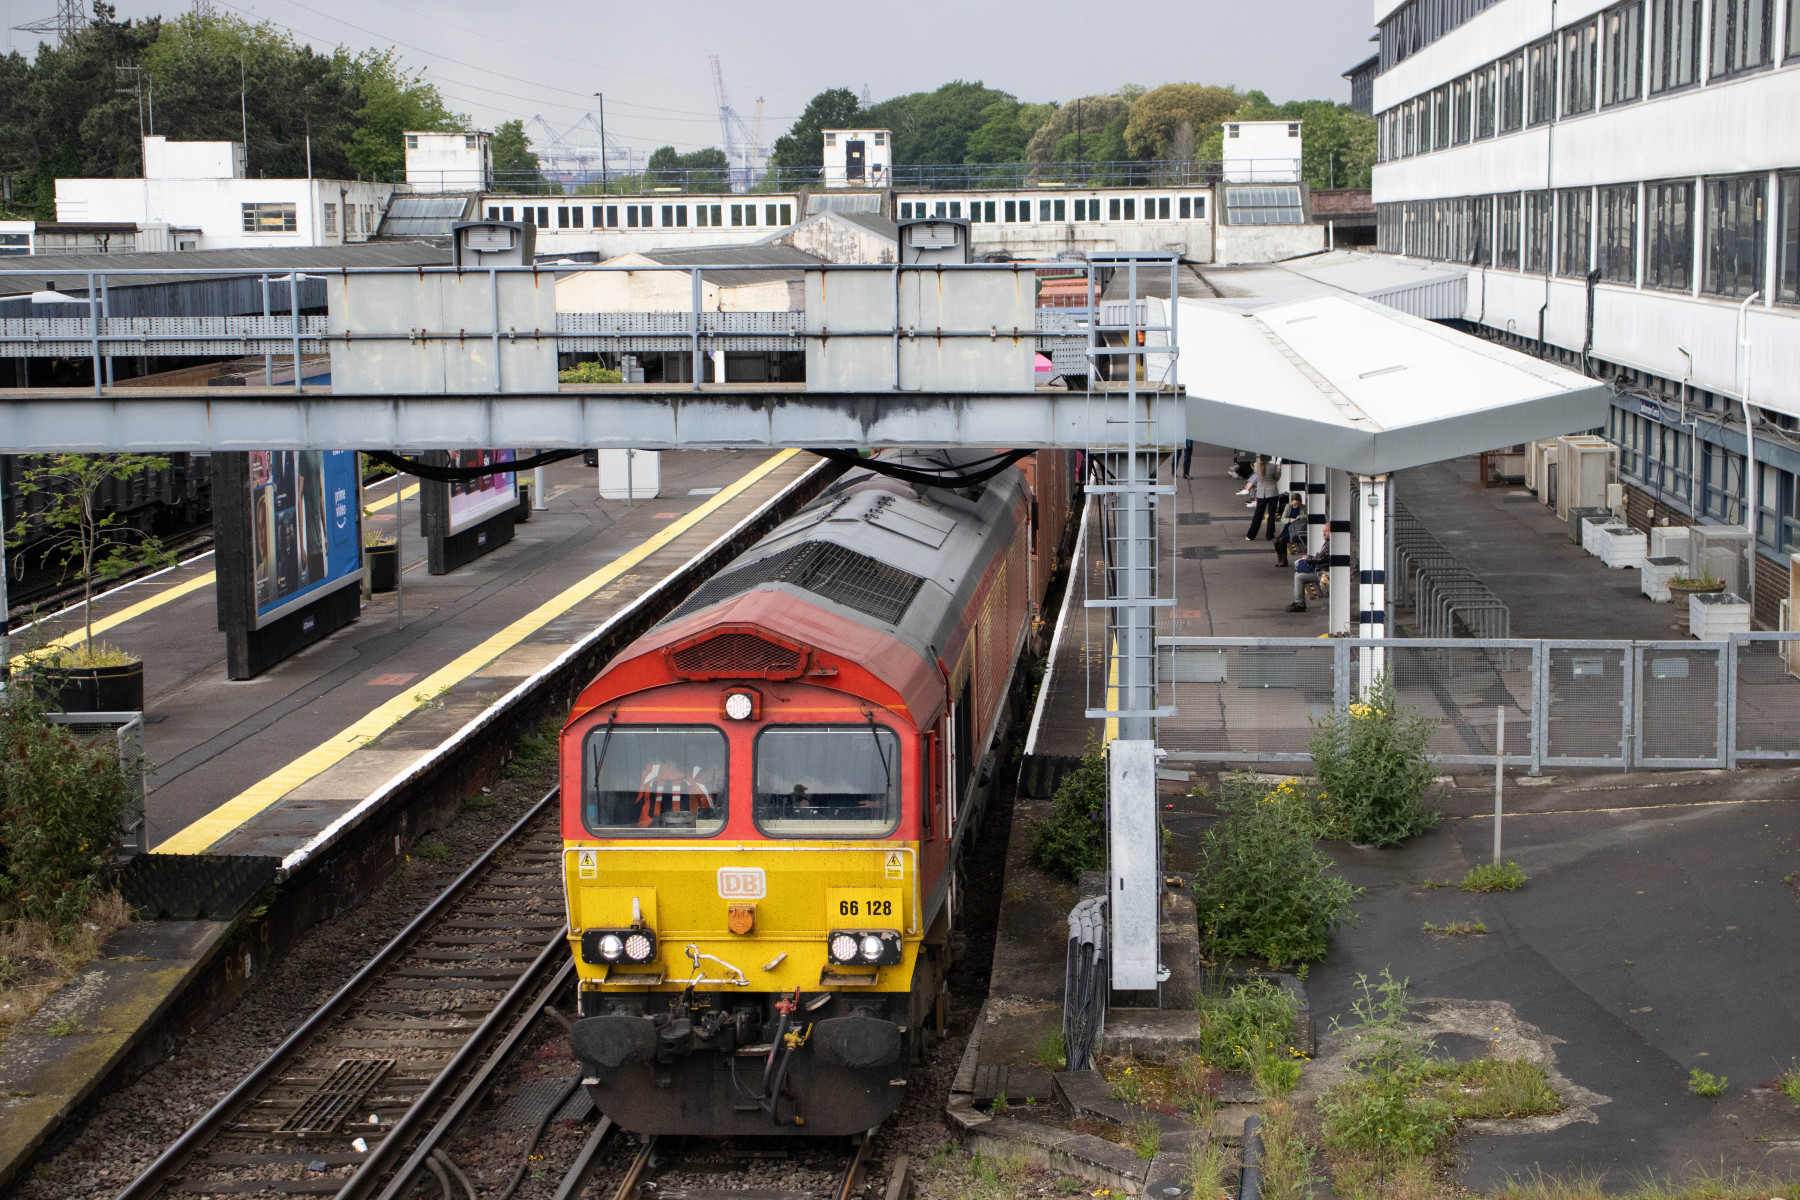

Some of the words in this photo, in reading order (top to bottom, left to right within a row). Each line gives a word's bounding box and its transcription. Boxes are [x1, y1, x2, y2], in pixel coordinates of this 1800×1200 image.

[335, 488, 346, 505] prime
[336, 503, 346, 517] video
[725, 874, 758, 892] DB
[839, 900, 859, 916] 66
[866, 900, 892, 916] 128
